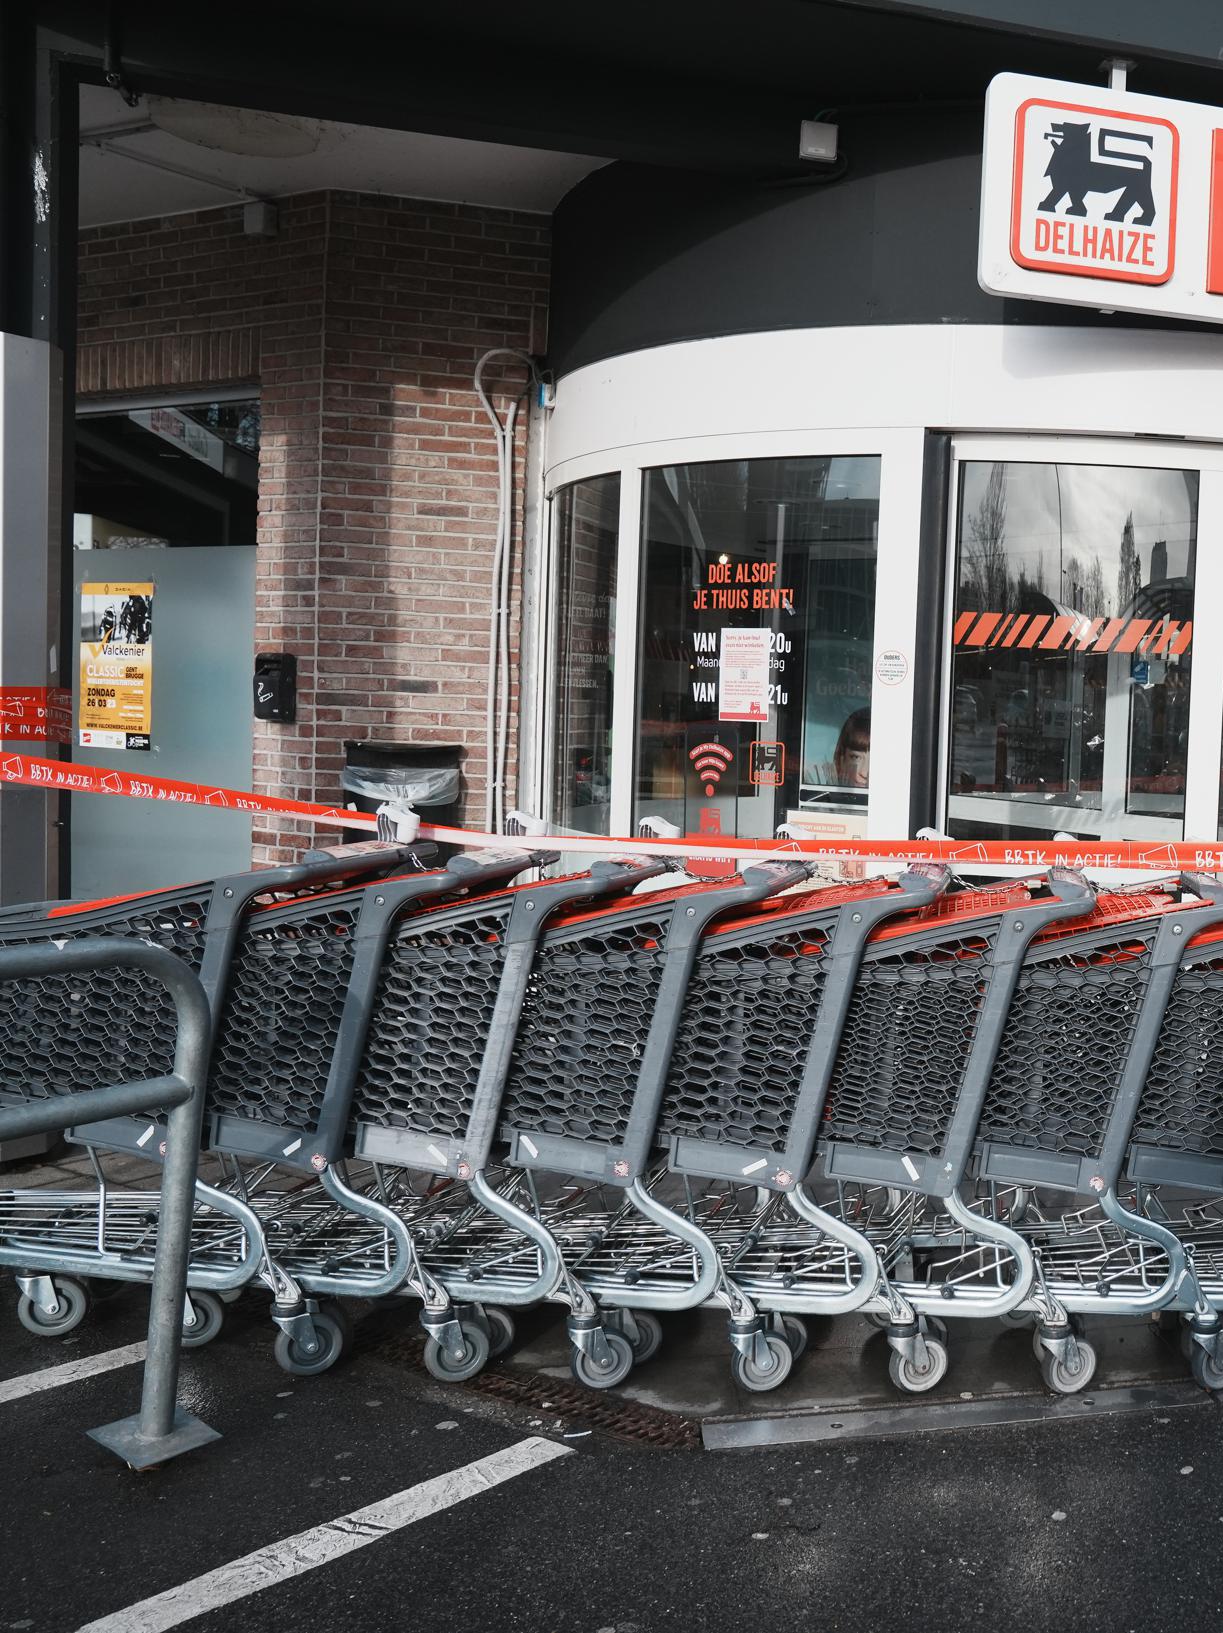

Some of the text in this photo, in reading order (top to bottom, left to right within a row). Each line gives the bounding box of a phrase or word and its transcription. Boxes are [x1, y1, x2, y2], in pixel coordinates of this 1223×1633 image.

[1034, 218, 1156, 267] DELHAIZE
[708, 562, 777, 584] DOE ALSOF
[693, 588, 794, 610] JE THUIS BENT!
[102, 644, 145, 657] Valckenier
[693, 632, 792, 654] VAN 20u
[87, 664, 125, 677] CLASSIC
[697, 655, 722, 668] Maan
[768, 657, 785, 672] dag
[87, 687, 116, 698] ZONDAG
[87, 698, 96, 707] 26
[97, 698, 107, 708] 03
[692, 682, 716, 703] VAN
[767, 684, 788, 705] 21u
[30, 764, 93, 788] BBTK IN ACTIE!
[130, 780, 197, 803] BBTK IN ACTIE!
[1004, 849, 1122, 868] BBTK IN ACTIE!
